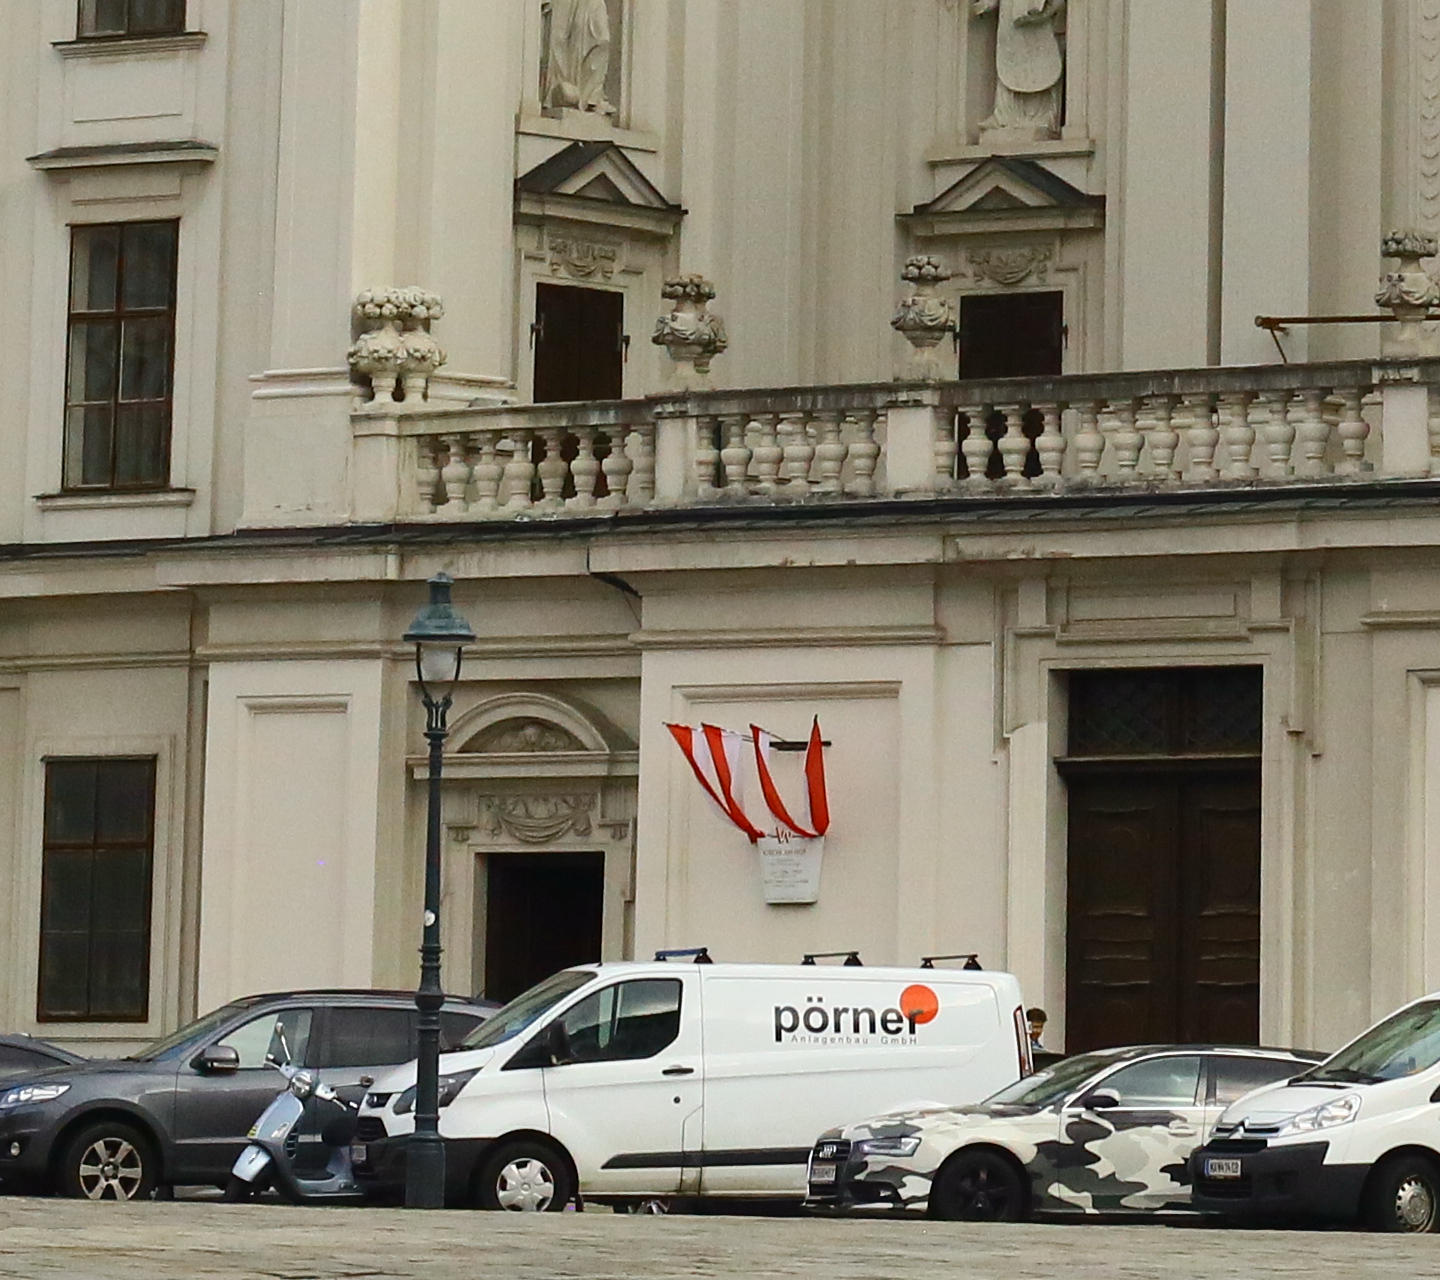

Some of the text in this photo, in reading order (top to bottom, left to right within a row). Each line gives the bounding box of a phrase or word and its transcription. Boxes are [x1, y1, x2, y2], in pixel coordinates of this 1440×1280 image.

[774, 996, 924, 1043] pörner
[791, 1035, 917, 1045] Anlagenbau GmbH
